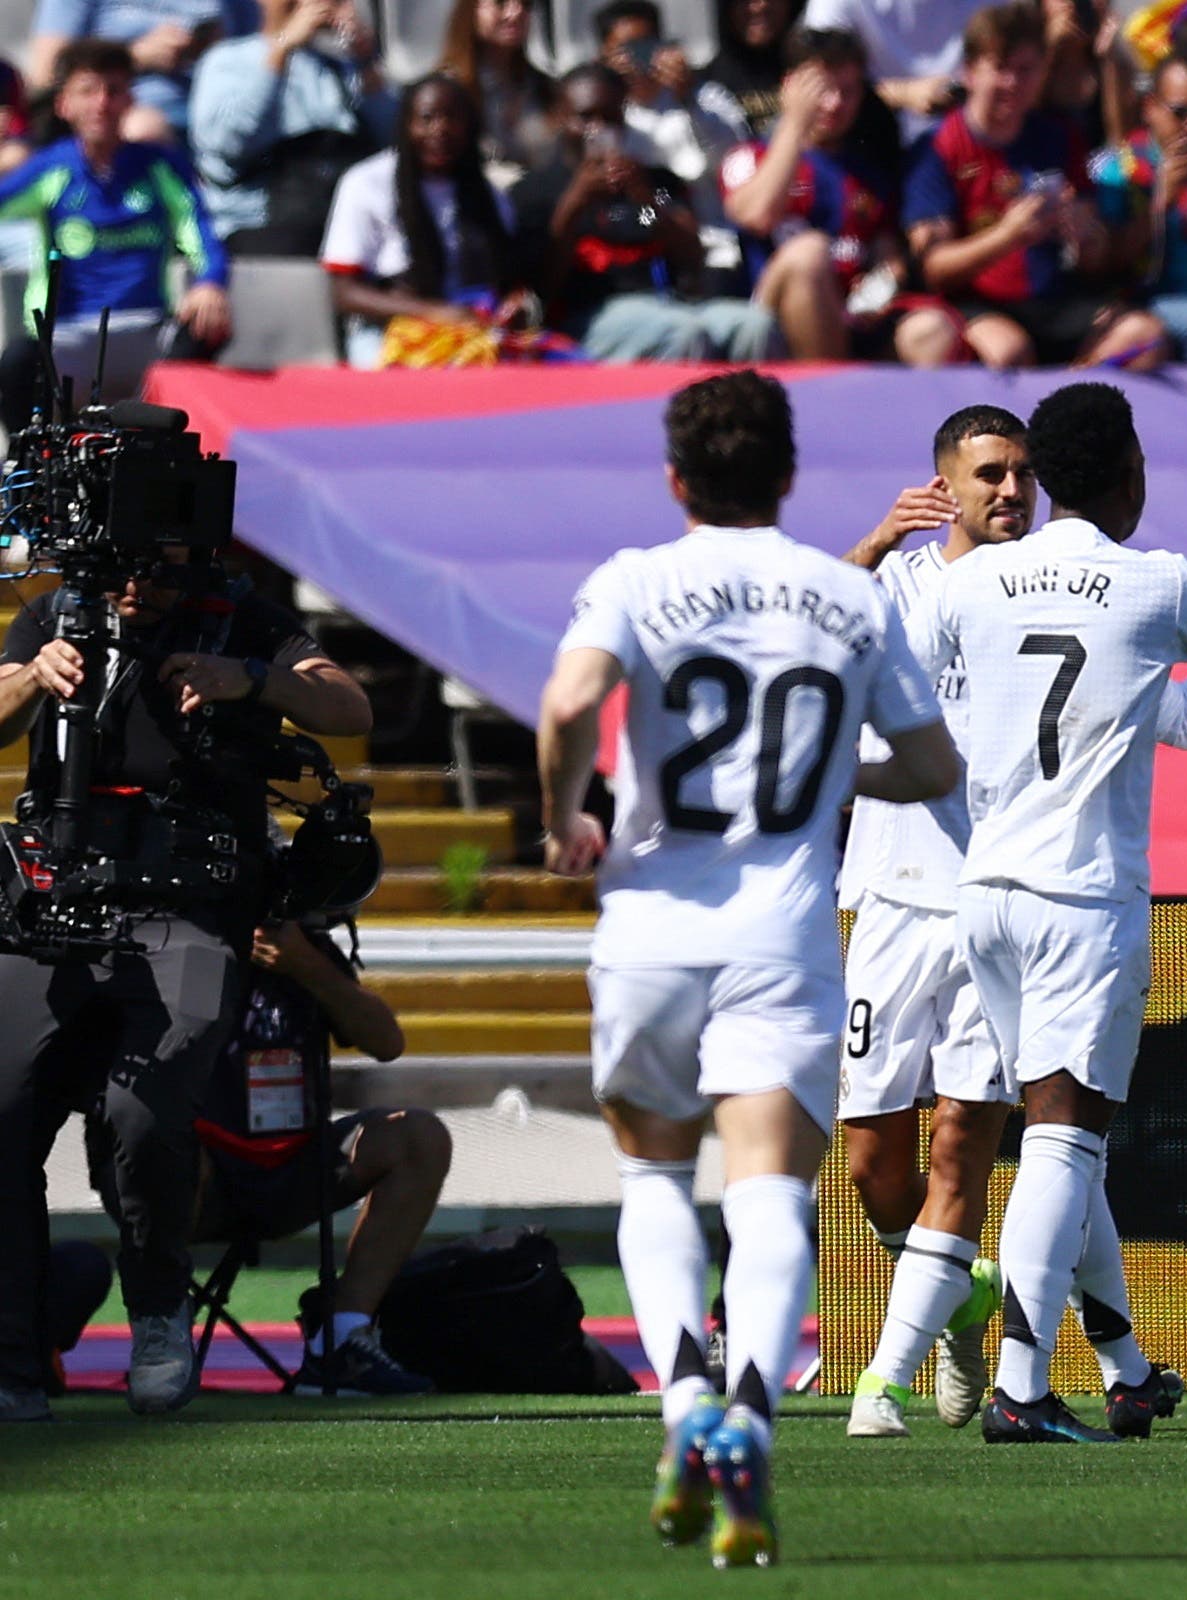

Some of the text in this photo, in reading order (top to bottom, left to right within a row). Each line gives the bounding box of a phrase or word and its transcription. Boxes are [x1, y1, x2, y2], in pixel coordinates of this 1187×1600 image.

[1067, 567, 1111, 608] JR.
[662, 657, 844, 833] 20
[1017, 634, 1087, 781] 7
[848, 998, 872, 1059] 9
